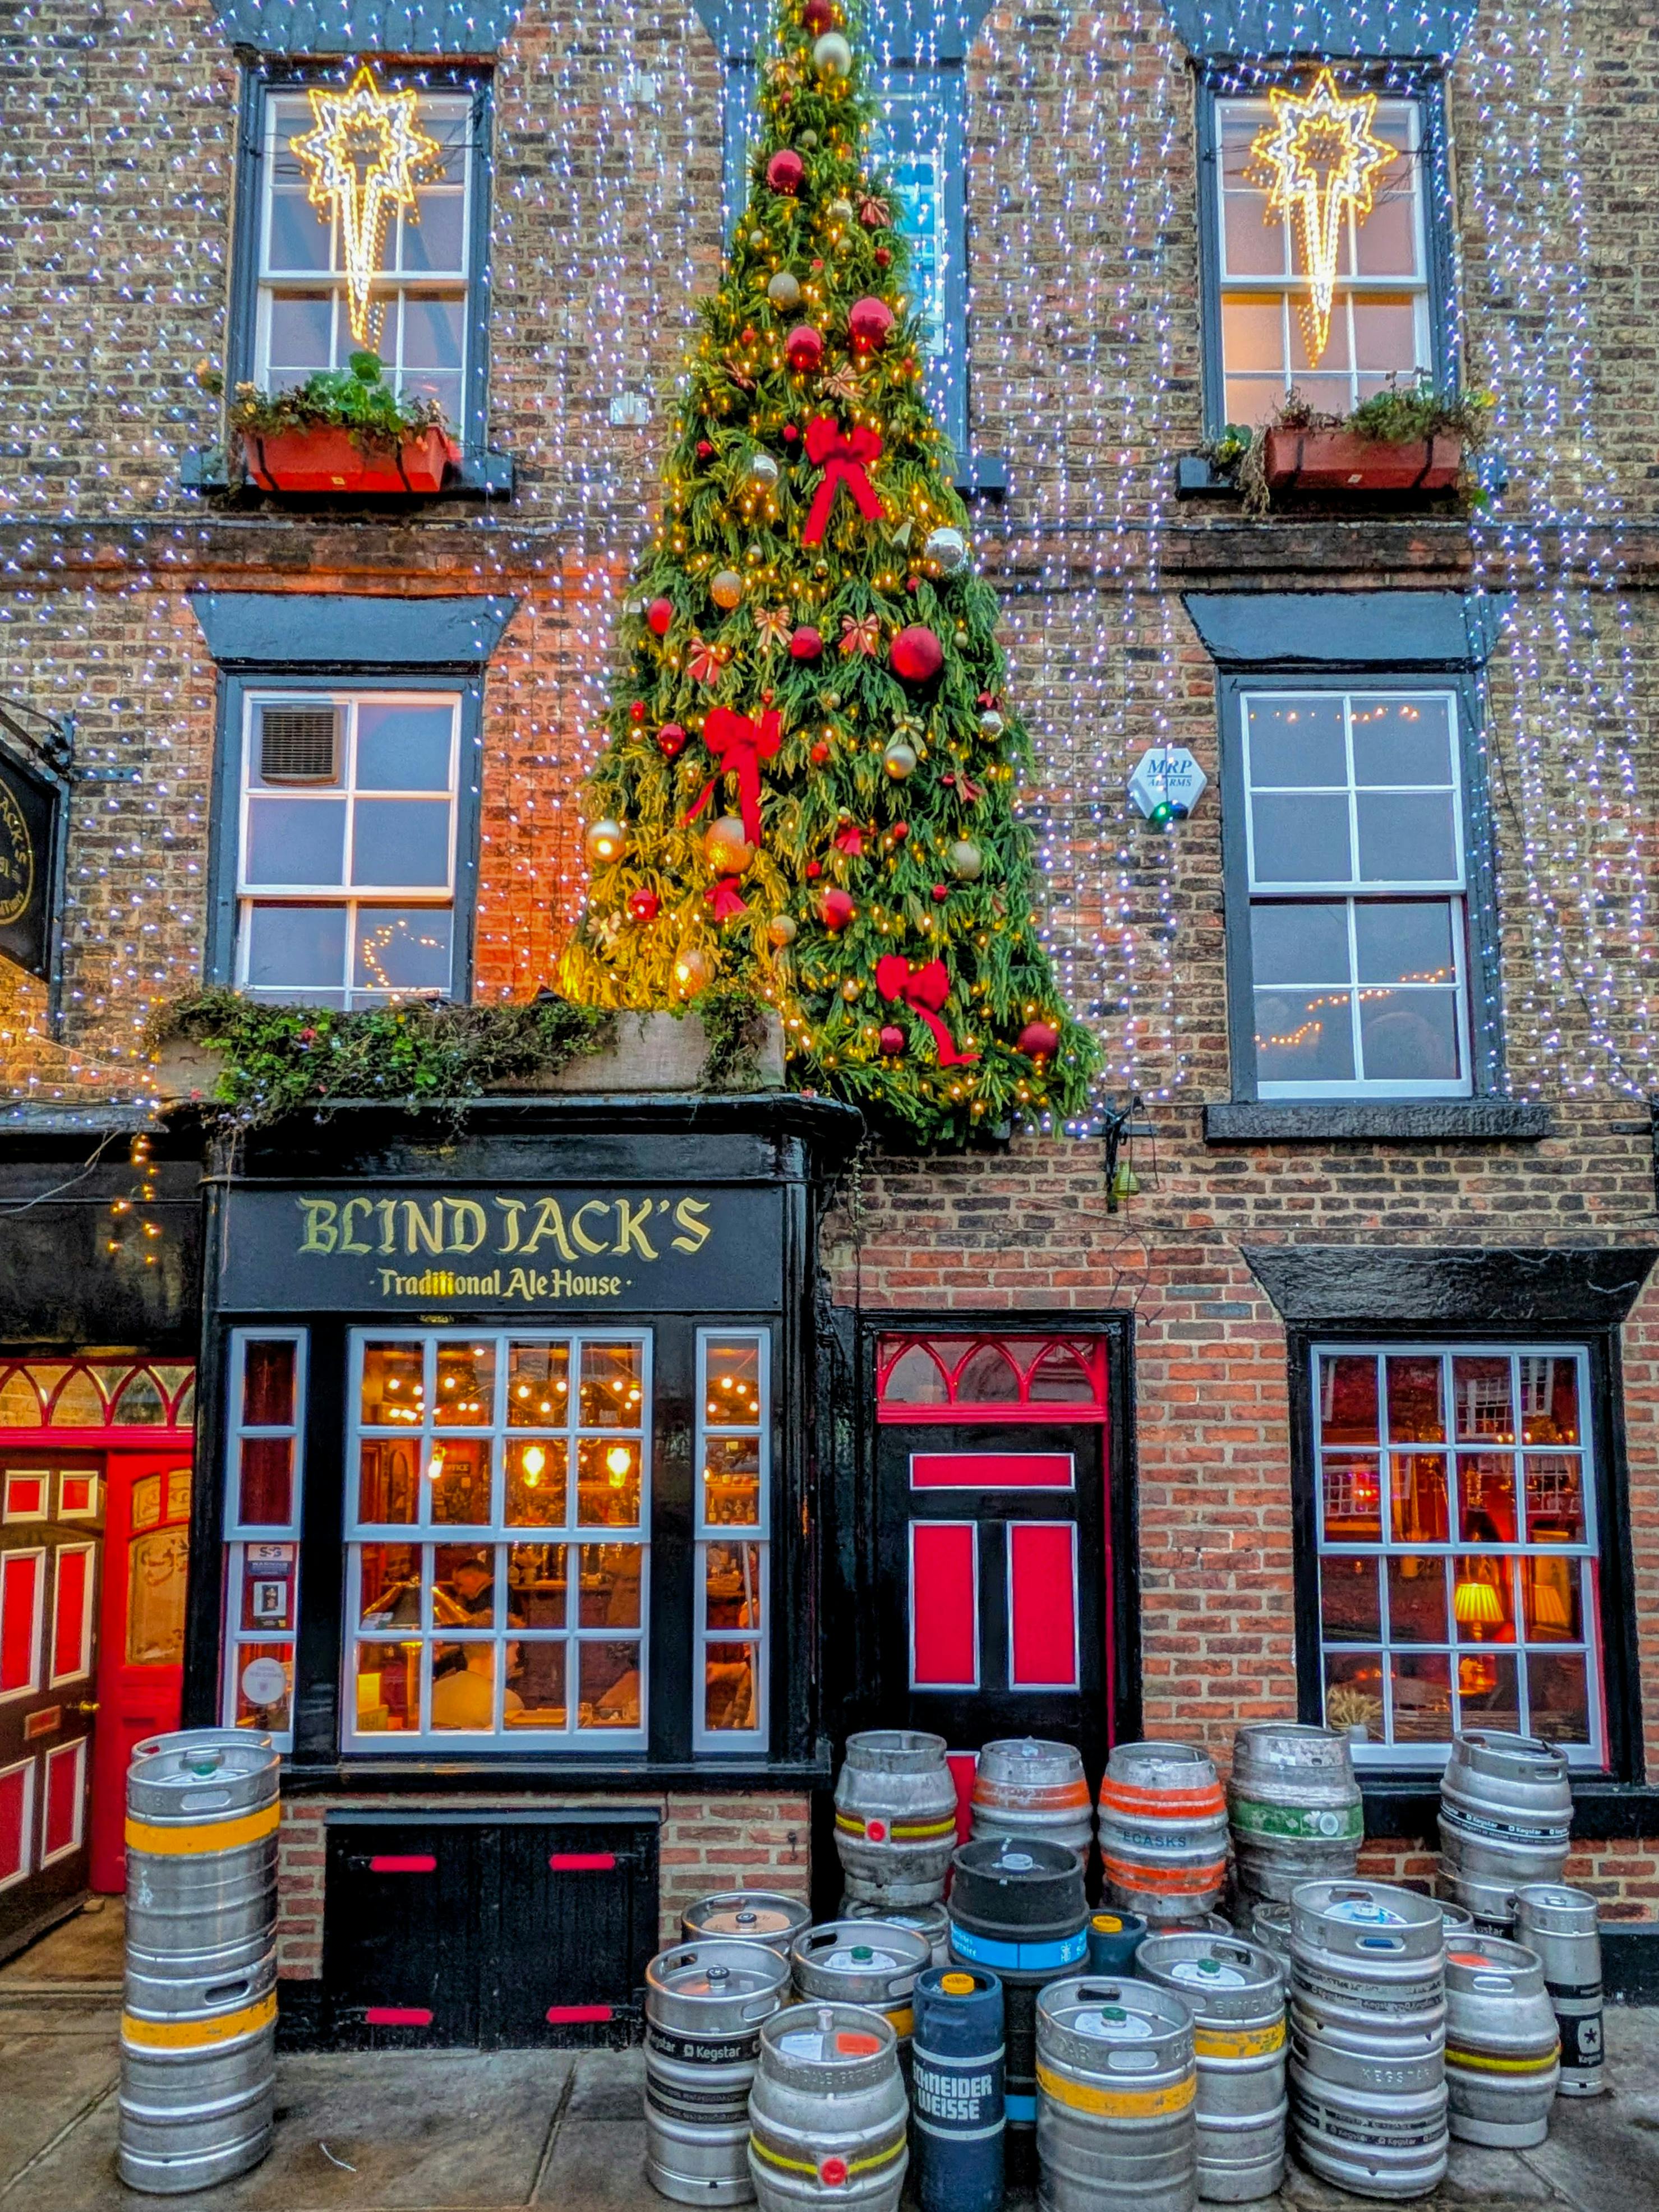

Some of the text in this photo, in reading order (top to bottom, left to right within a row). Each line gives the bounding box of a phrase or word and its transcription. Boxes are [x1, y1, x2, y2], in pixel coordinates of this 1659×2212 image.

[1148, 759, 1192, 773] MRP
[298, 1197, 711, 1260] BLIND JACK'S
[377, 1267, 621, 1301] Traditional Ale House
[1516, 1827, 1542, 1835] Kegstar
[697, 2044, 741, 2062] Kegstar
[918, 2087, 980, 2120] WEISSE
